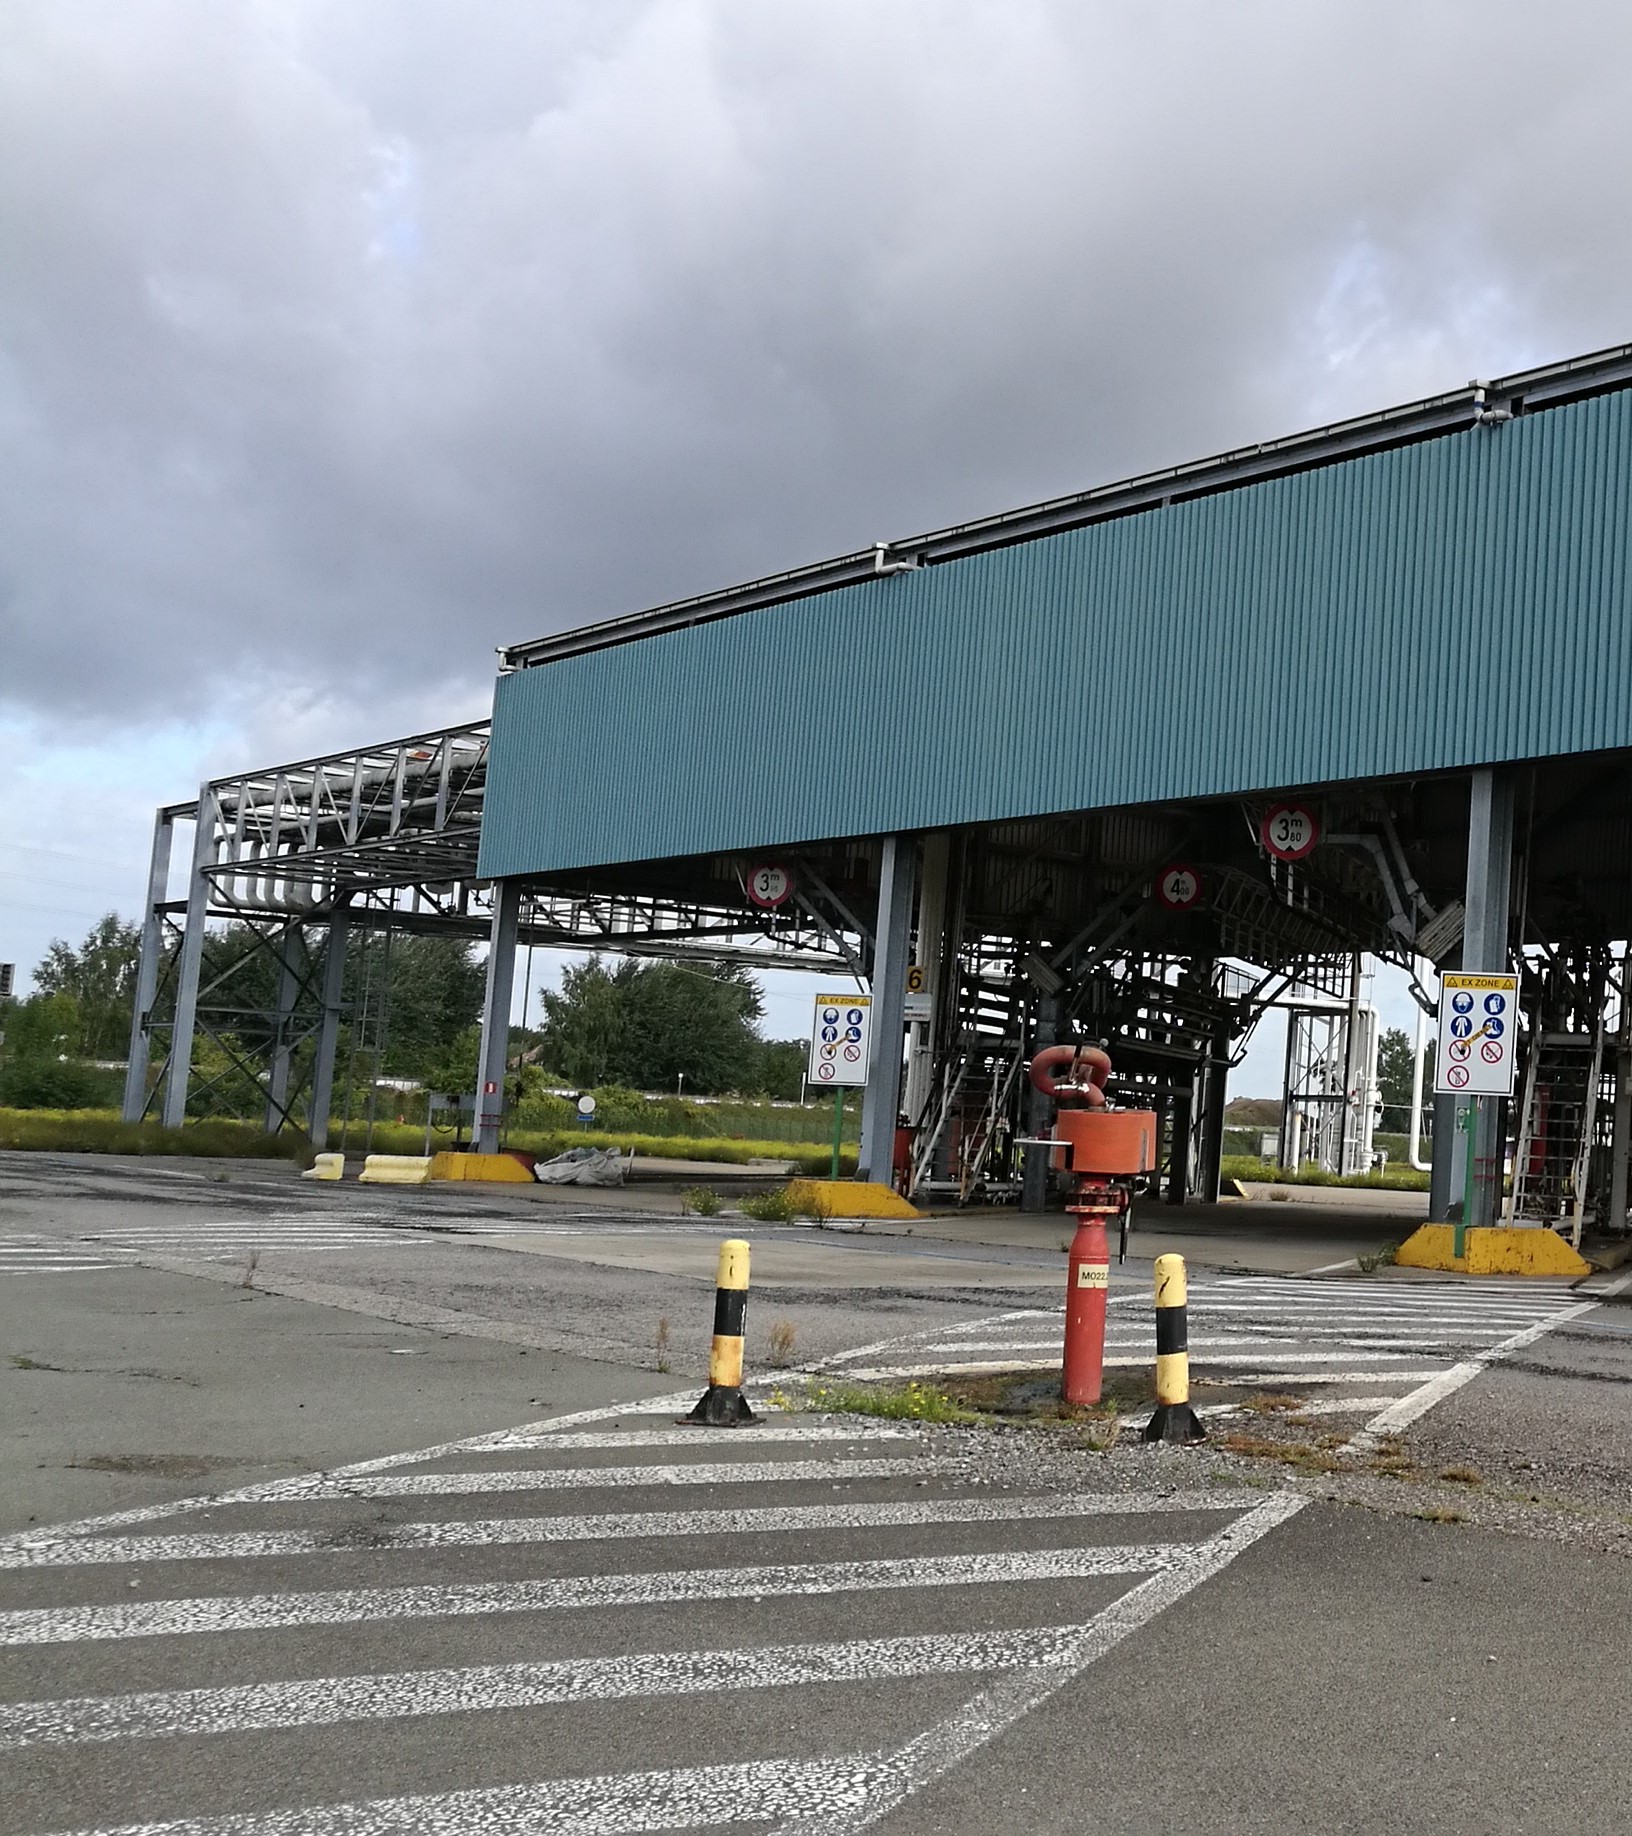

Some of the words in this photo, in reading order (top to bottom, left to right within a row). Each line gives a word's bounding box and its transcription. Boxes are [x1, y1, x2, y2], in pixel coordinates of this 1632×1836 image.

[1277, 818, 1290, 842] 3
[759, 873, 769, 892] 3
[1171, 878, 1180, 896] 4
[908, 969, 922, 989] 6
[1475, 979, 1500, 988] ZONE
